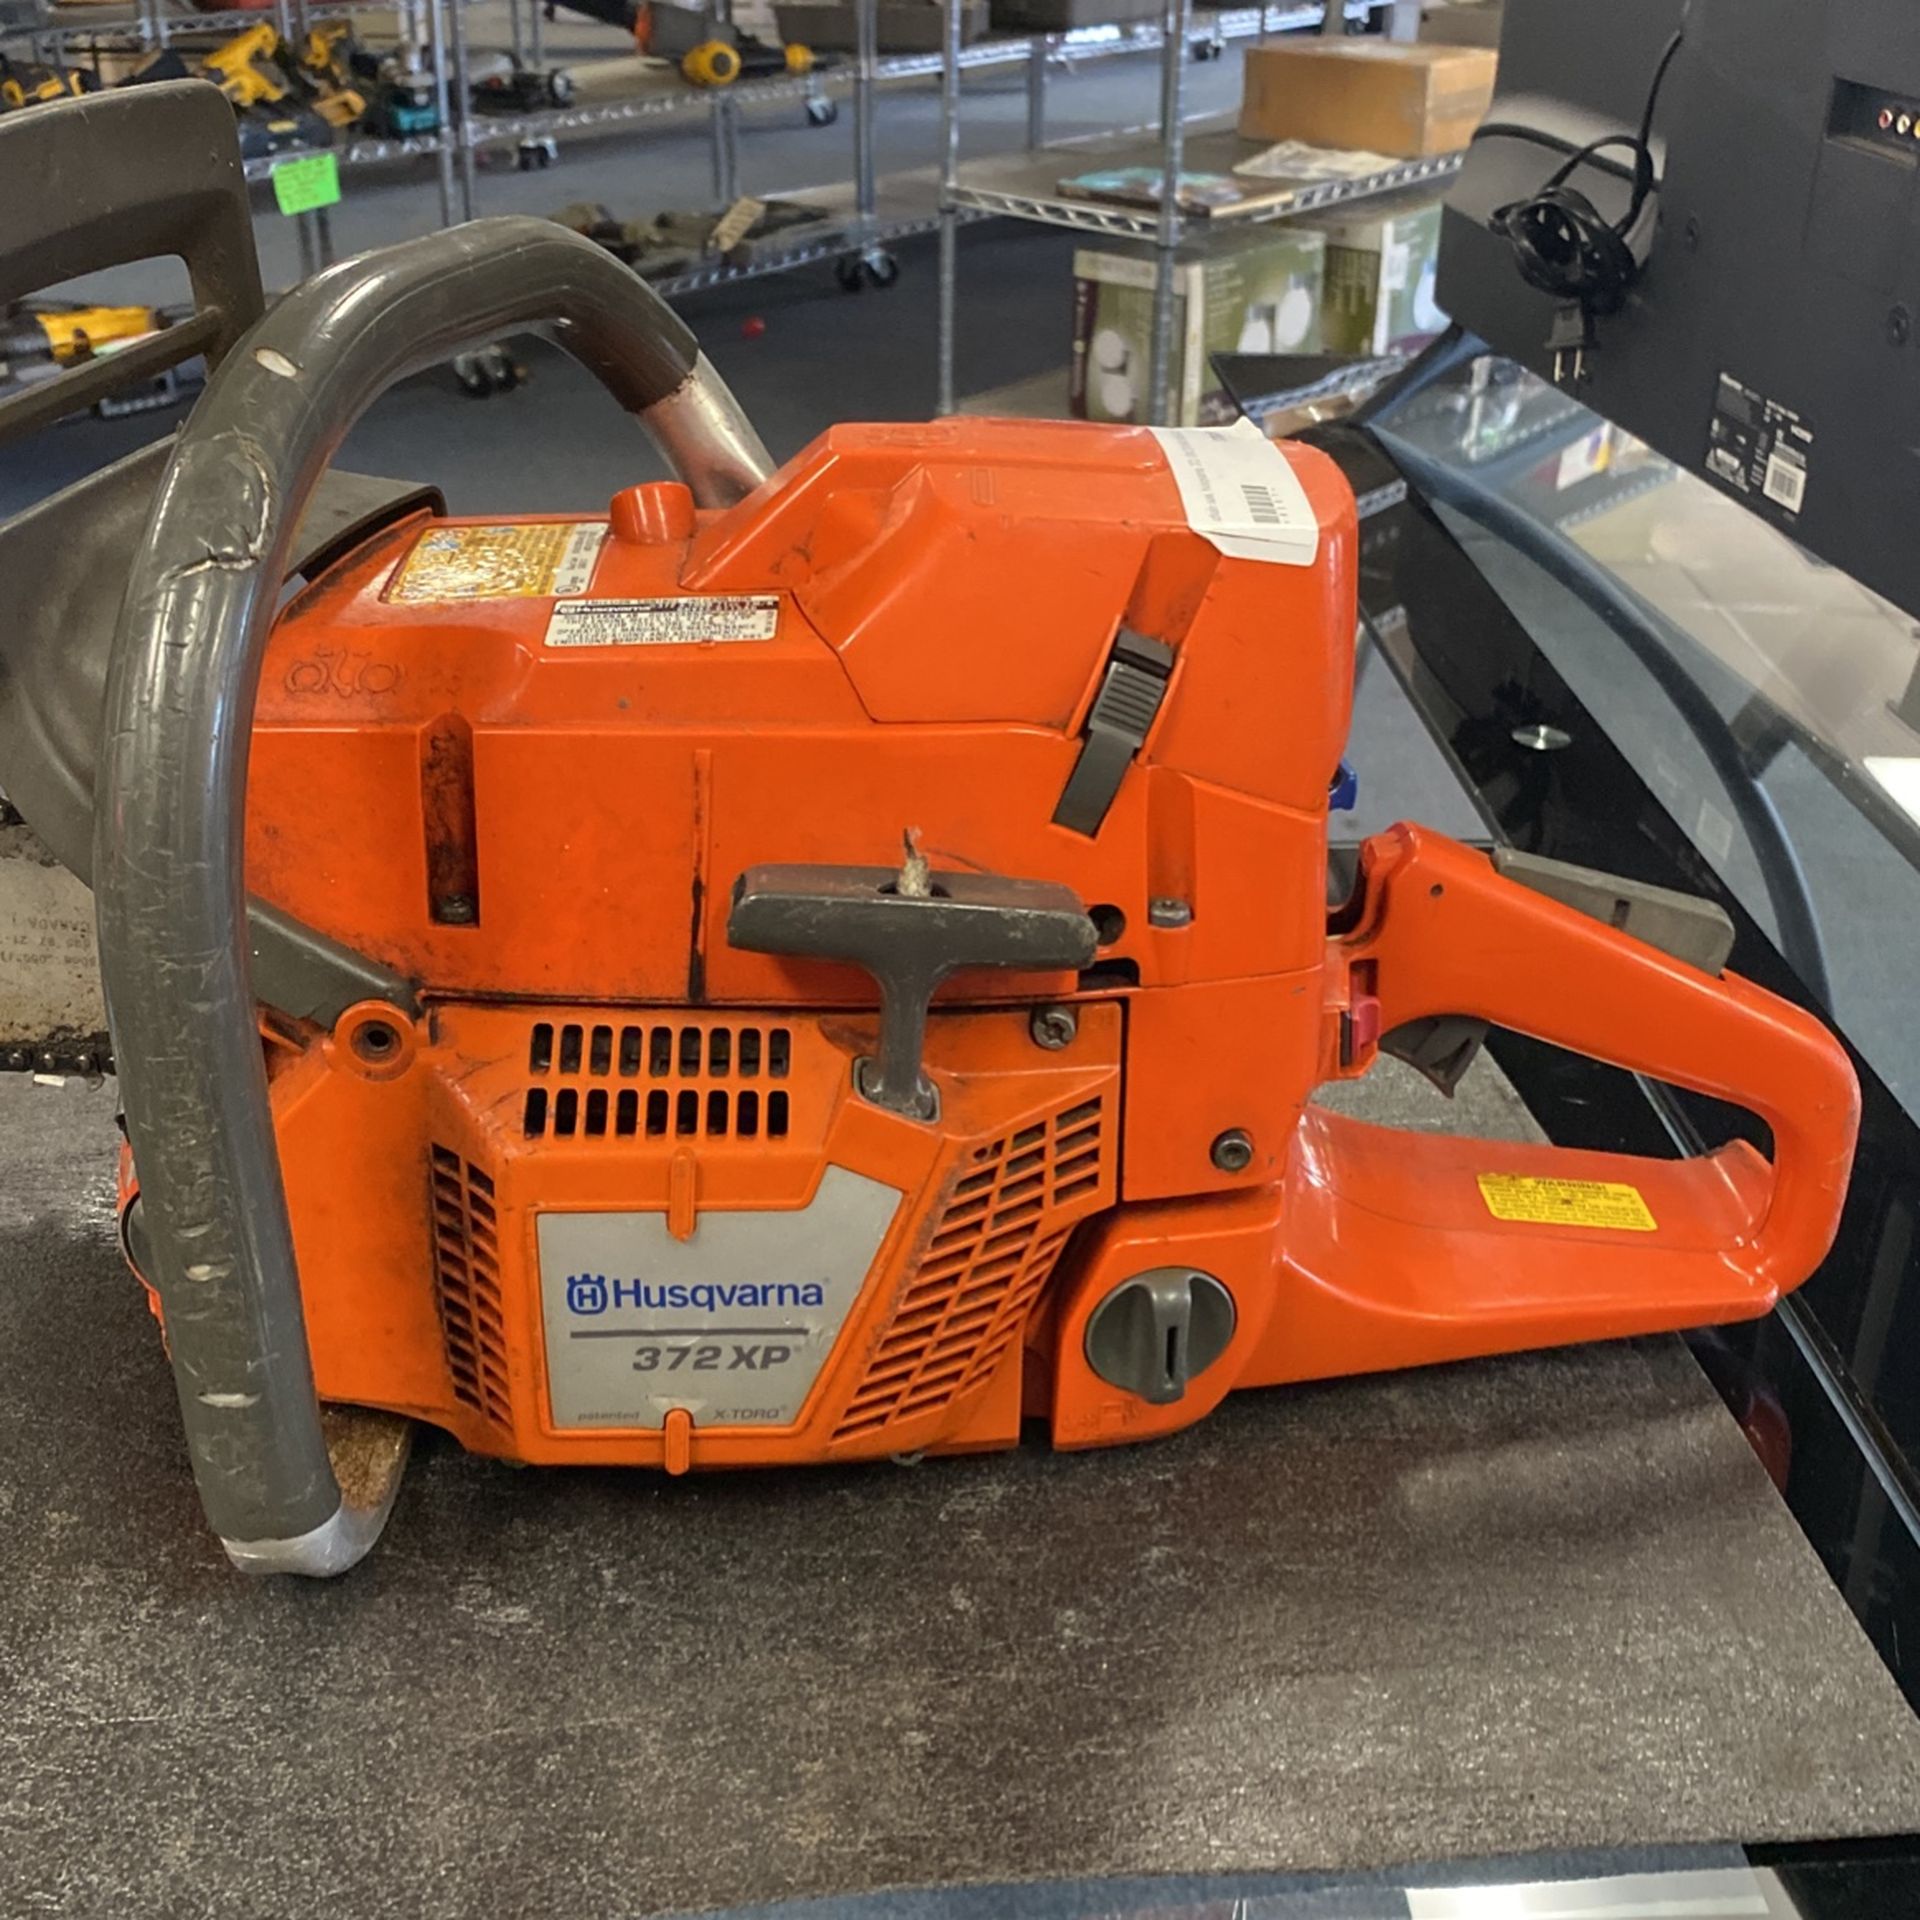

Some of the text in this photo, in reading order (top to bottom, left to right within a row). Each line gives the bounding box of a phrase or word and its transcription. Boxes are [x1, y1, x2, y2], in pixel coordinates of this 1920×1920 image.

[613, 1278, 824, 1312] Husqvarna
[633, 1345, 791, 1371] 372 XP
[578, 1410, 640, 1422] patented
